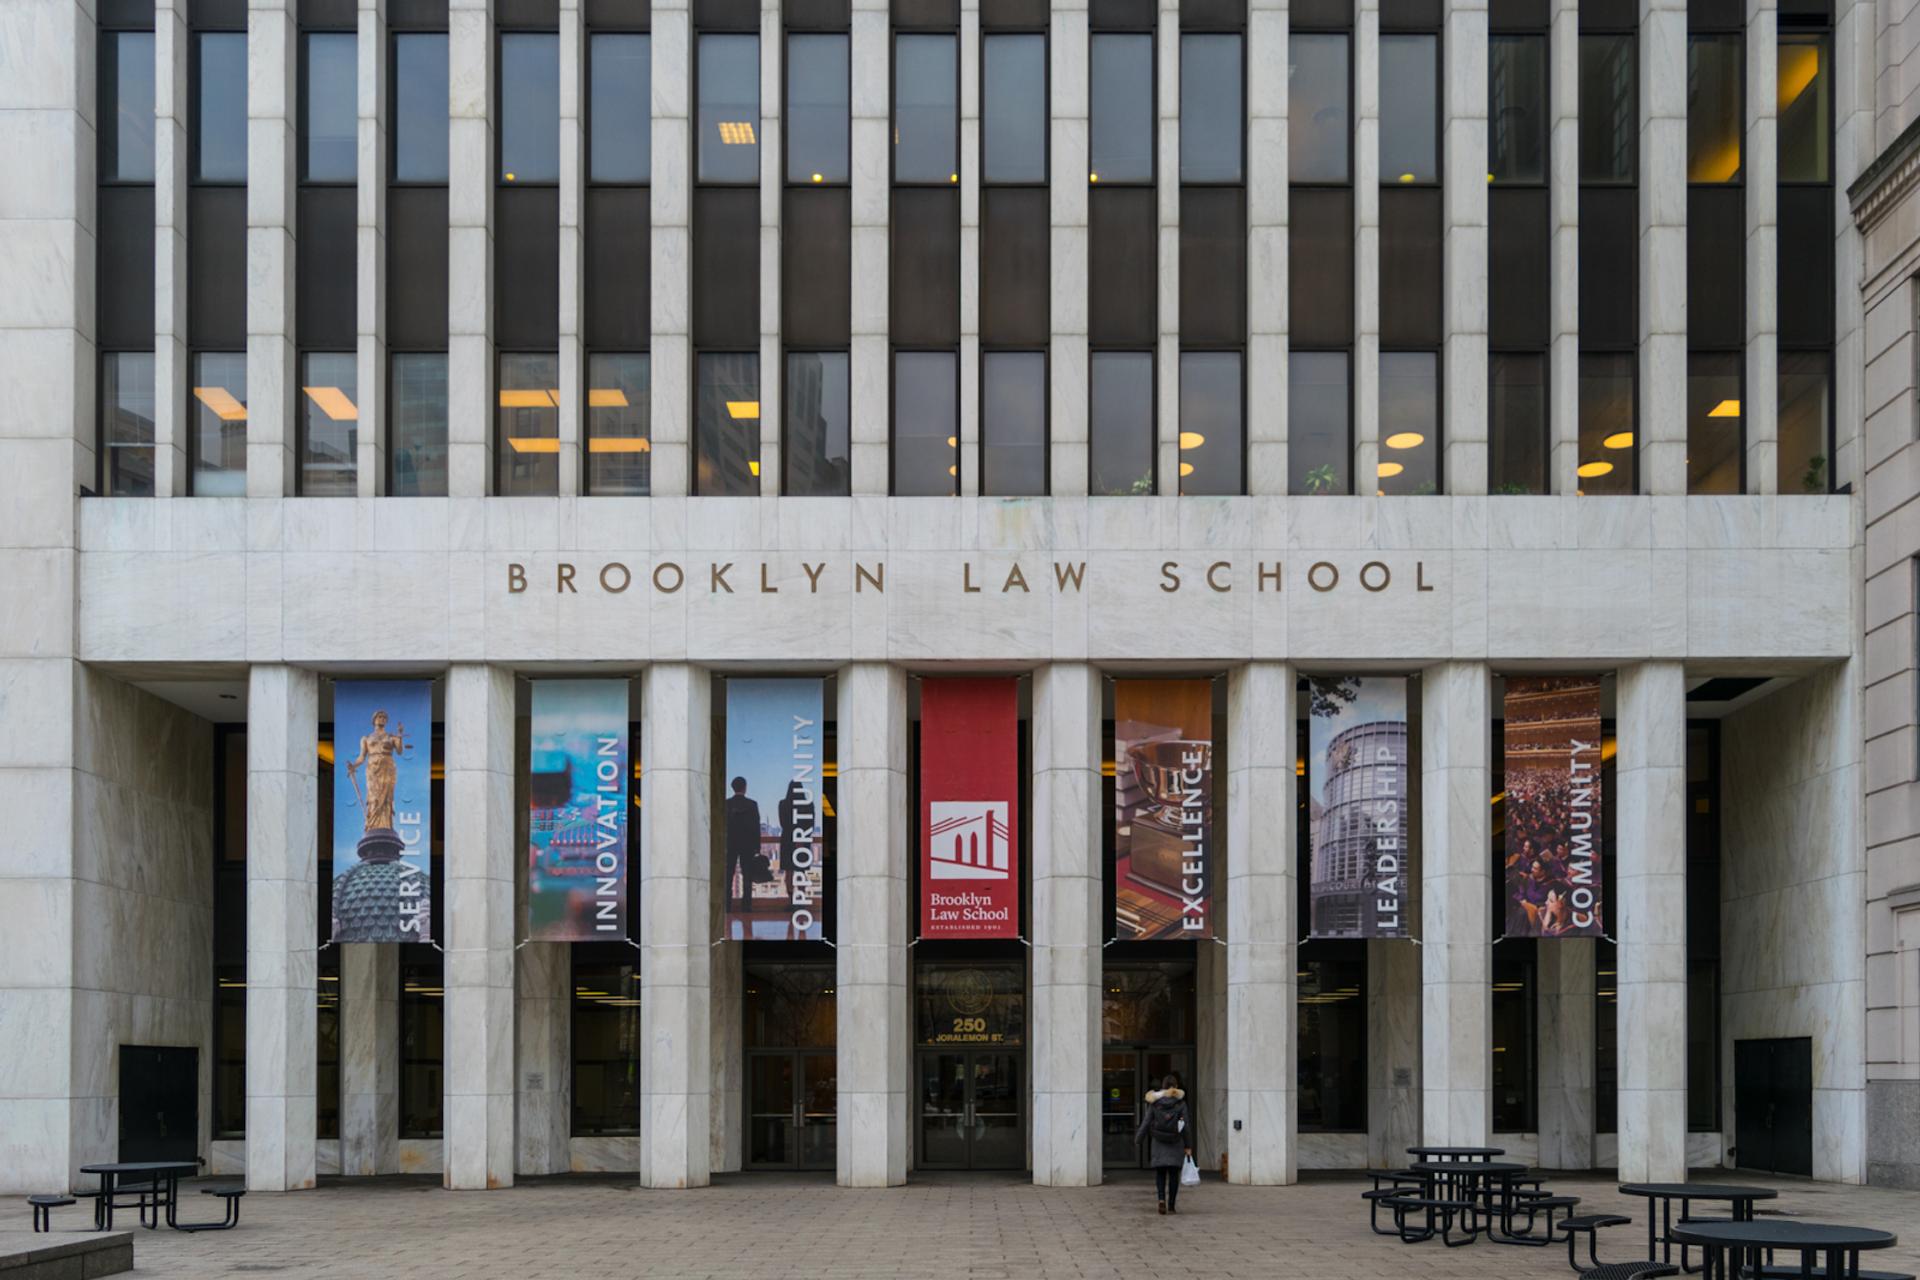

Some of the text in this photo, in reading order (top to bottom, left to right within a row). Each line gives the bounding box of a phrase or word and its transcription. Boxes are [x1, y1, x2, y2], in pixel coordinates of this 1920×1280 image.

[508, 561, 1434, 594] BROOKLYN LAW SCHOOL
[399, 811, 422, 933] SERVICE
[595, 736, 619, 931] INNOVATION
[791, 714, 815, 931] OPPORTUNITY
[1181, 750, 1205, 931] EXCELLENCE
[1376, 746, 1399, 929] LEADERSHIP
[1570, 738, 1594, 928] COMMUNITY
[930, 892, 992, 909] Brooklyn
[930, 907, 1009, 921] Law School
[936, 1033, 988, 1042] JORALEMON
[953, 1018, 986, 1033] 250
